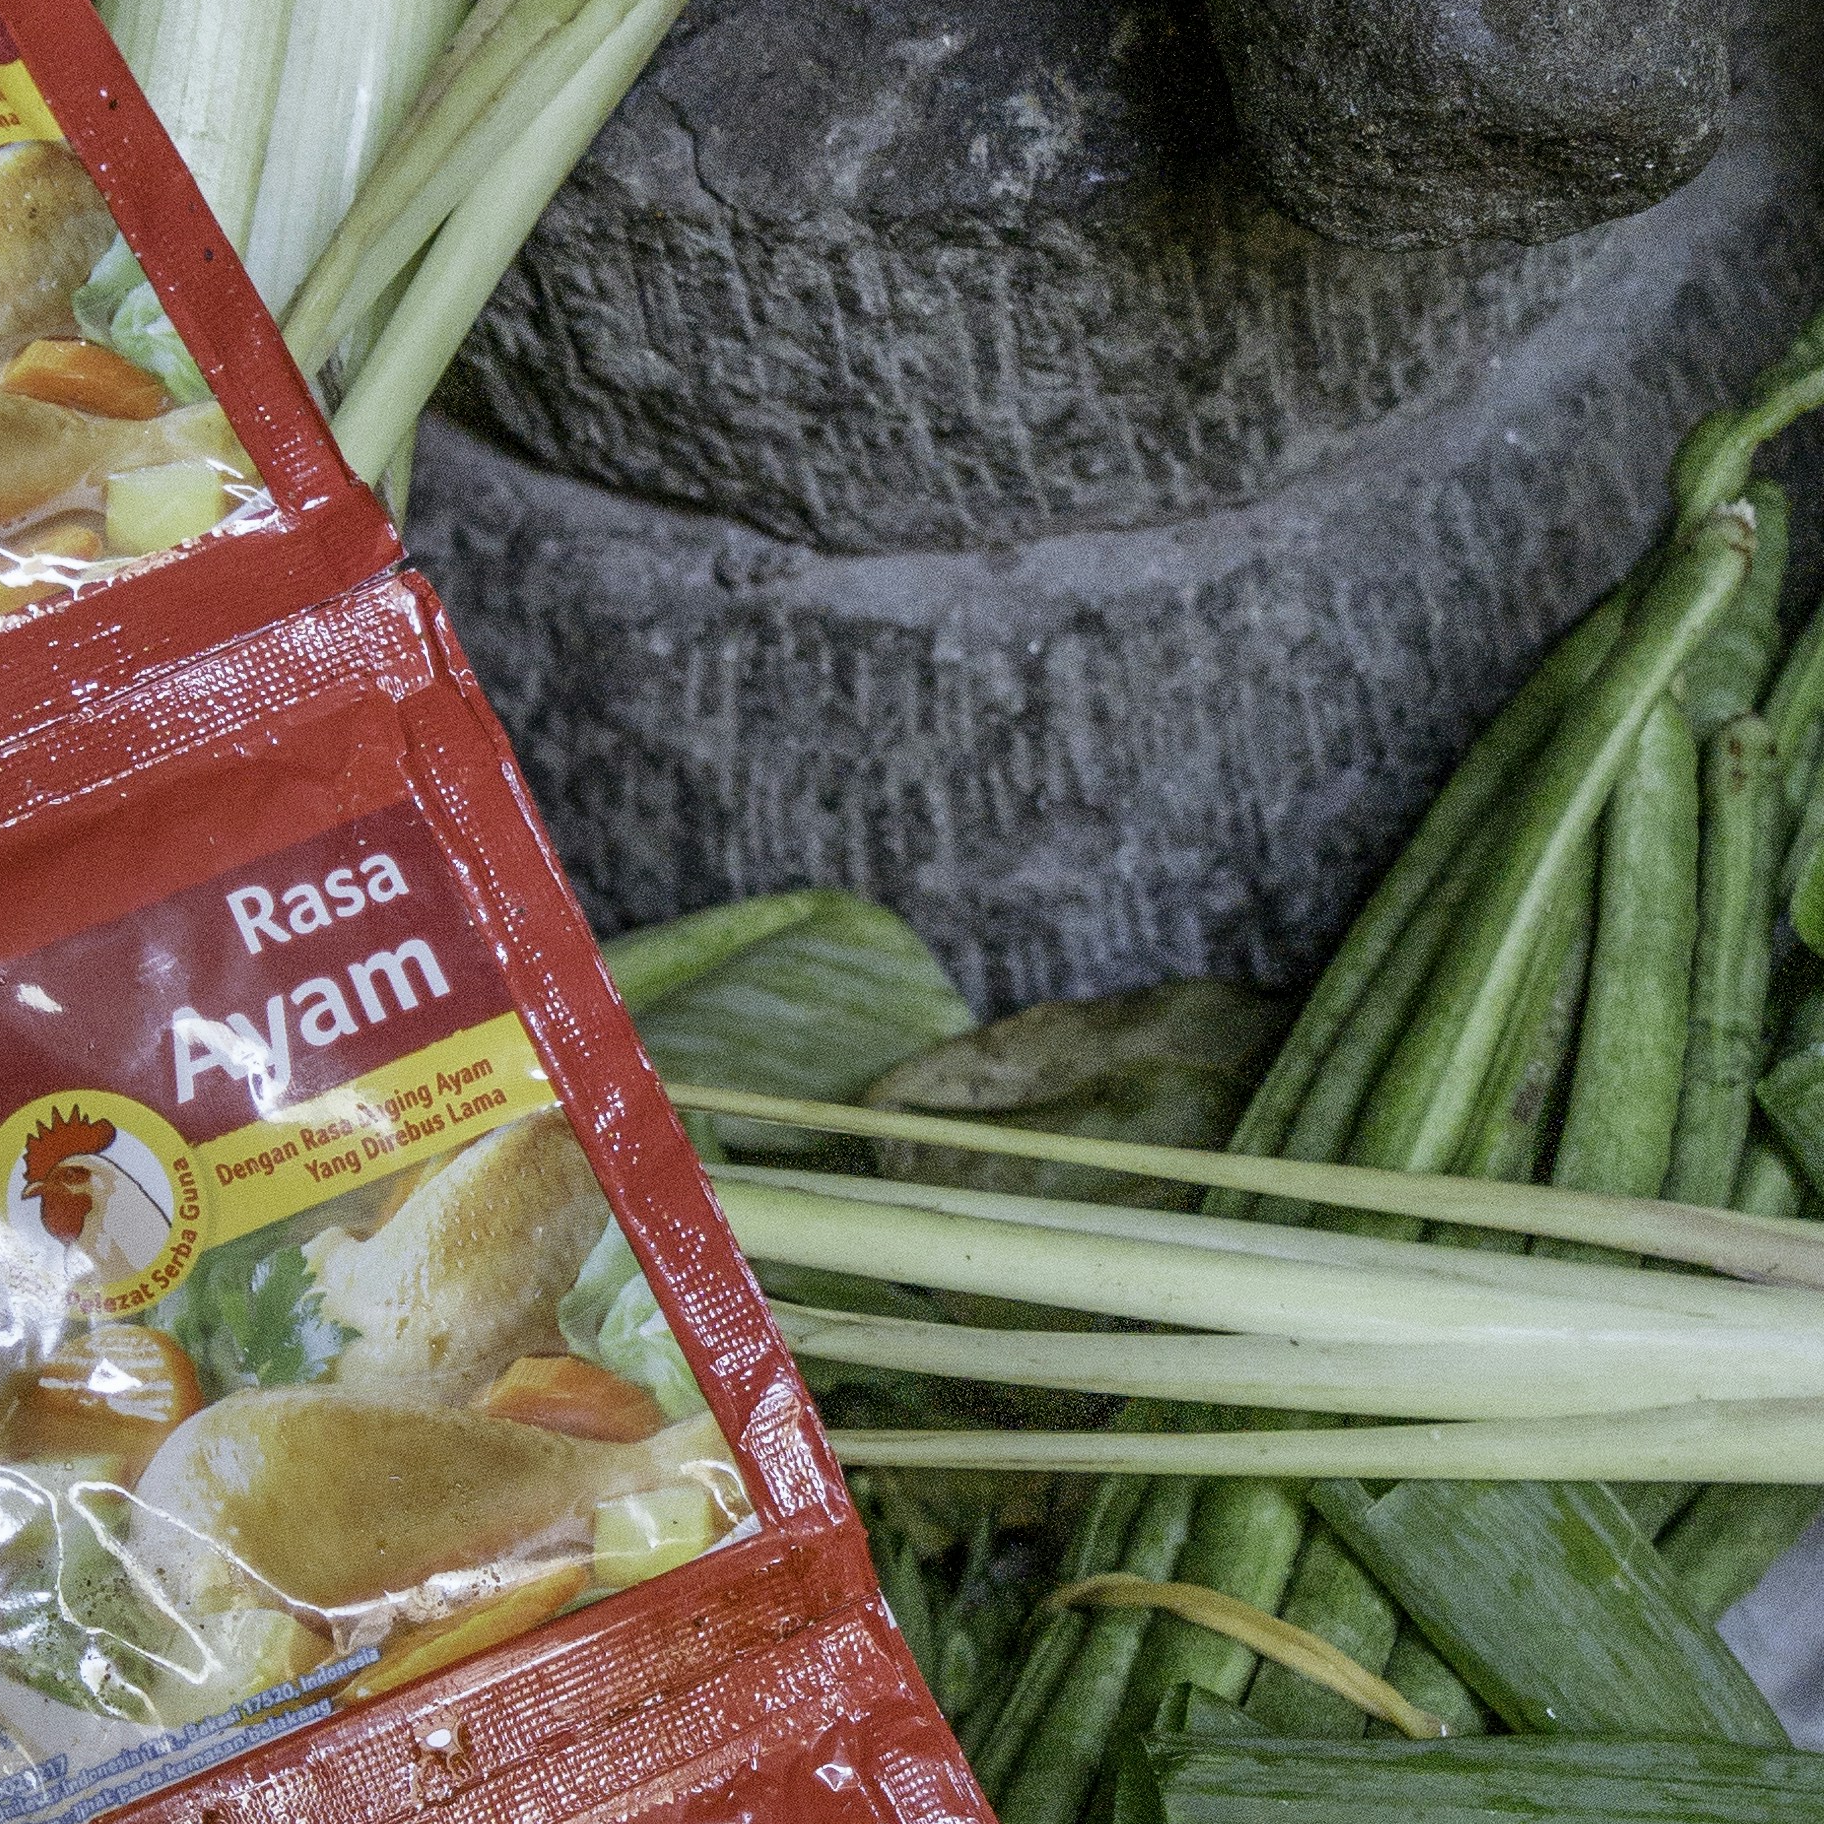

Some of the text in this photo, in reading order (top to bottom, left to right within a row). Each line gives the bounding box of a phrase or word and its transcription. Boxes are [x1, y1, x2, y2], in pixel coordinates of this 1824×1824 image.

[226, 853, 410, 955] Rasa
[172, 938, 450, 1105] Ayam
[214, 1056, 494, 1188] Dengan Rasa Dging Ayam
[304, 1087, 508, 1183] Yang Direbus Lama
[172, 1156, 201, 1222] Guna
[150, 1228, 198, 1290] Serba
[62, 1749, 143, 1796] Indonesia
[299, 1646, 381, 1693] Indonesia
[74, 1791, 116, 1822] lihat
[116, 1772, 164, 1806] pada
[163, 1734, 248, 1779] kemasan
[247, 1699, 333, 1744] belakang
